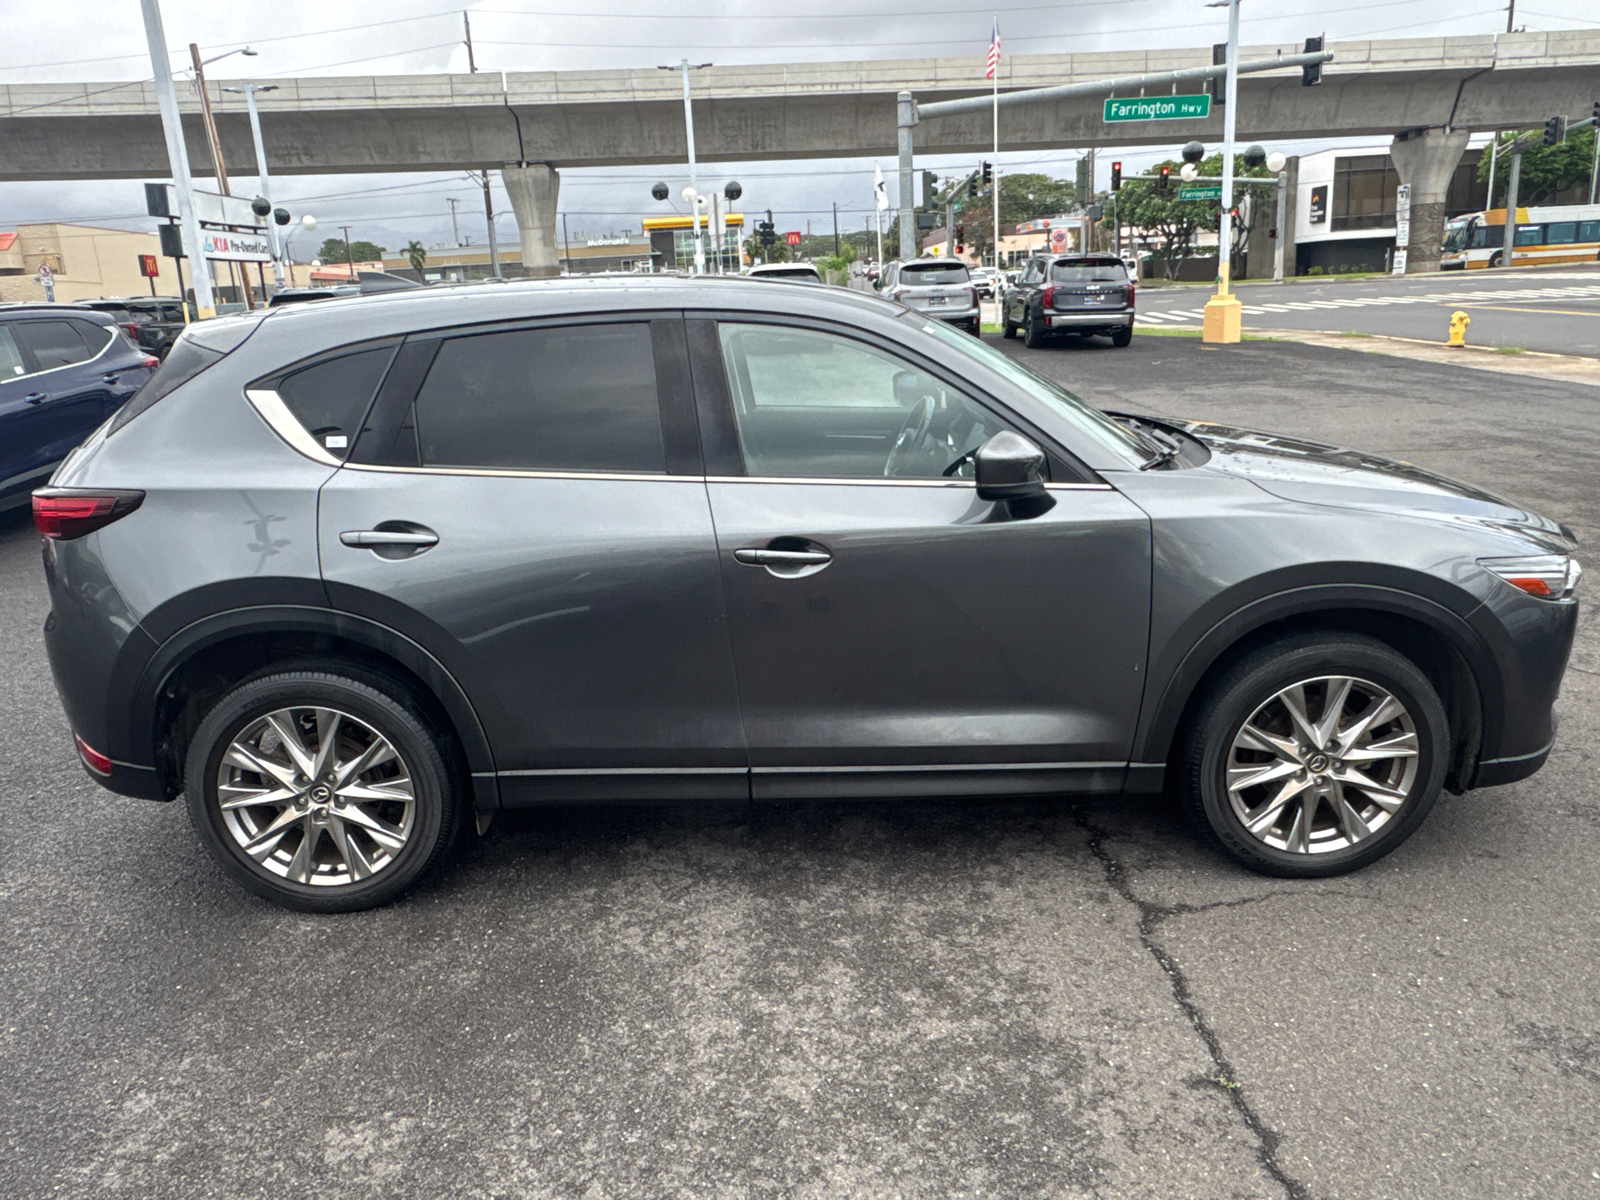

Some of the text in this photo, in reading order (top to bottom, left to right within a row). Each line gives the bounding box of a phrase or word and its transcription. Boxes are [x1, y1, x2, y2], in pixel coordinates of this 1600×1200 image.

[1111, 101, 1202, 119] Farrington Hwy
[1181, 190, 1216, 199] Farrington
[212, 236, 230, 253] KIA
